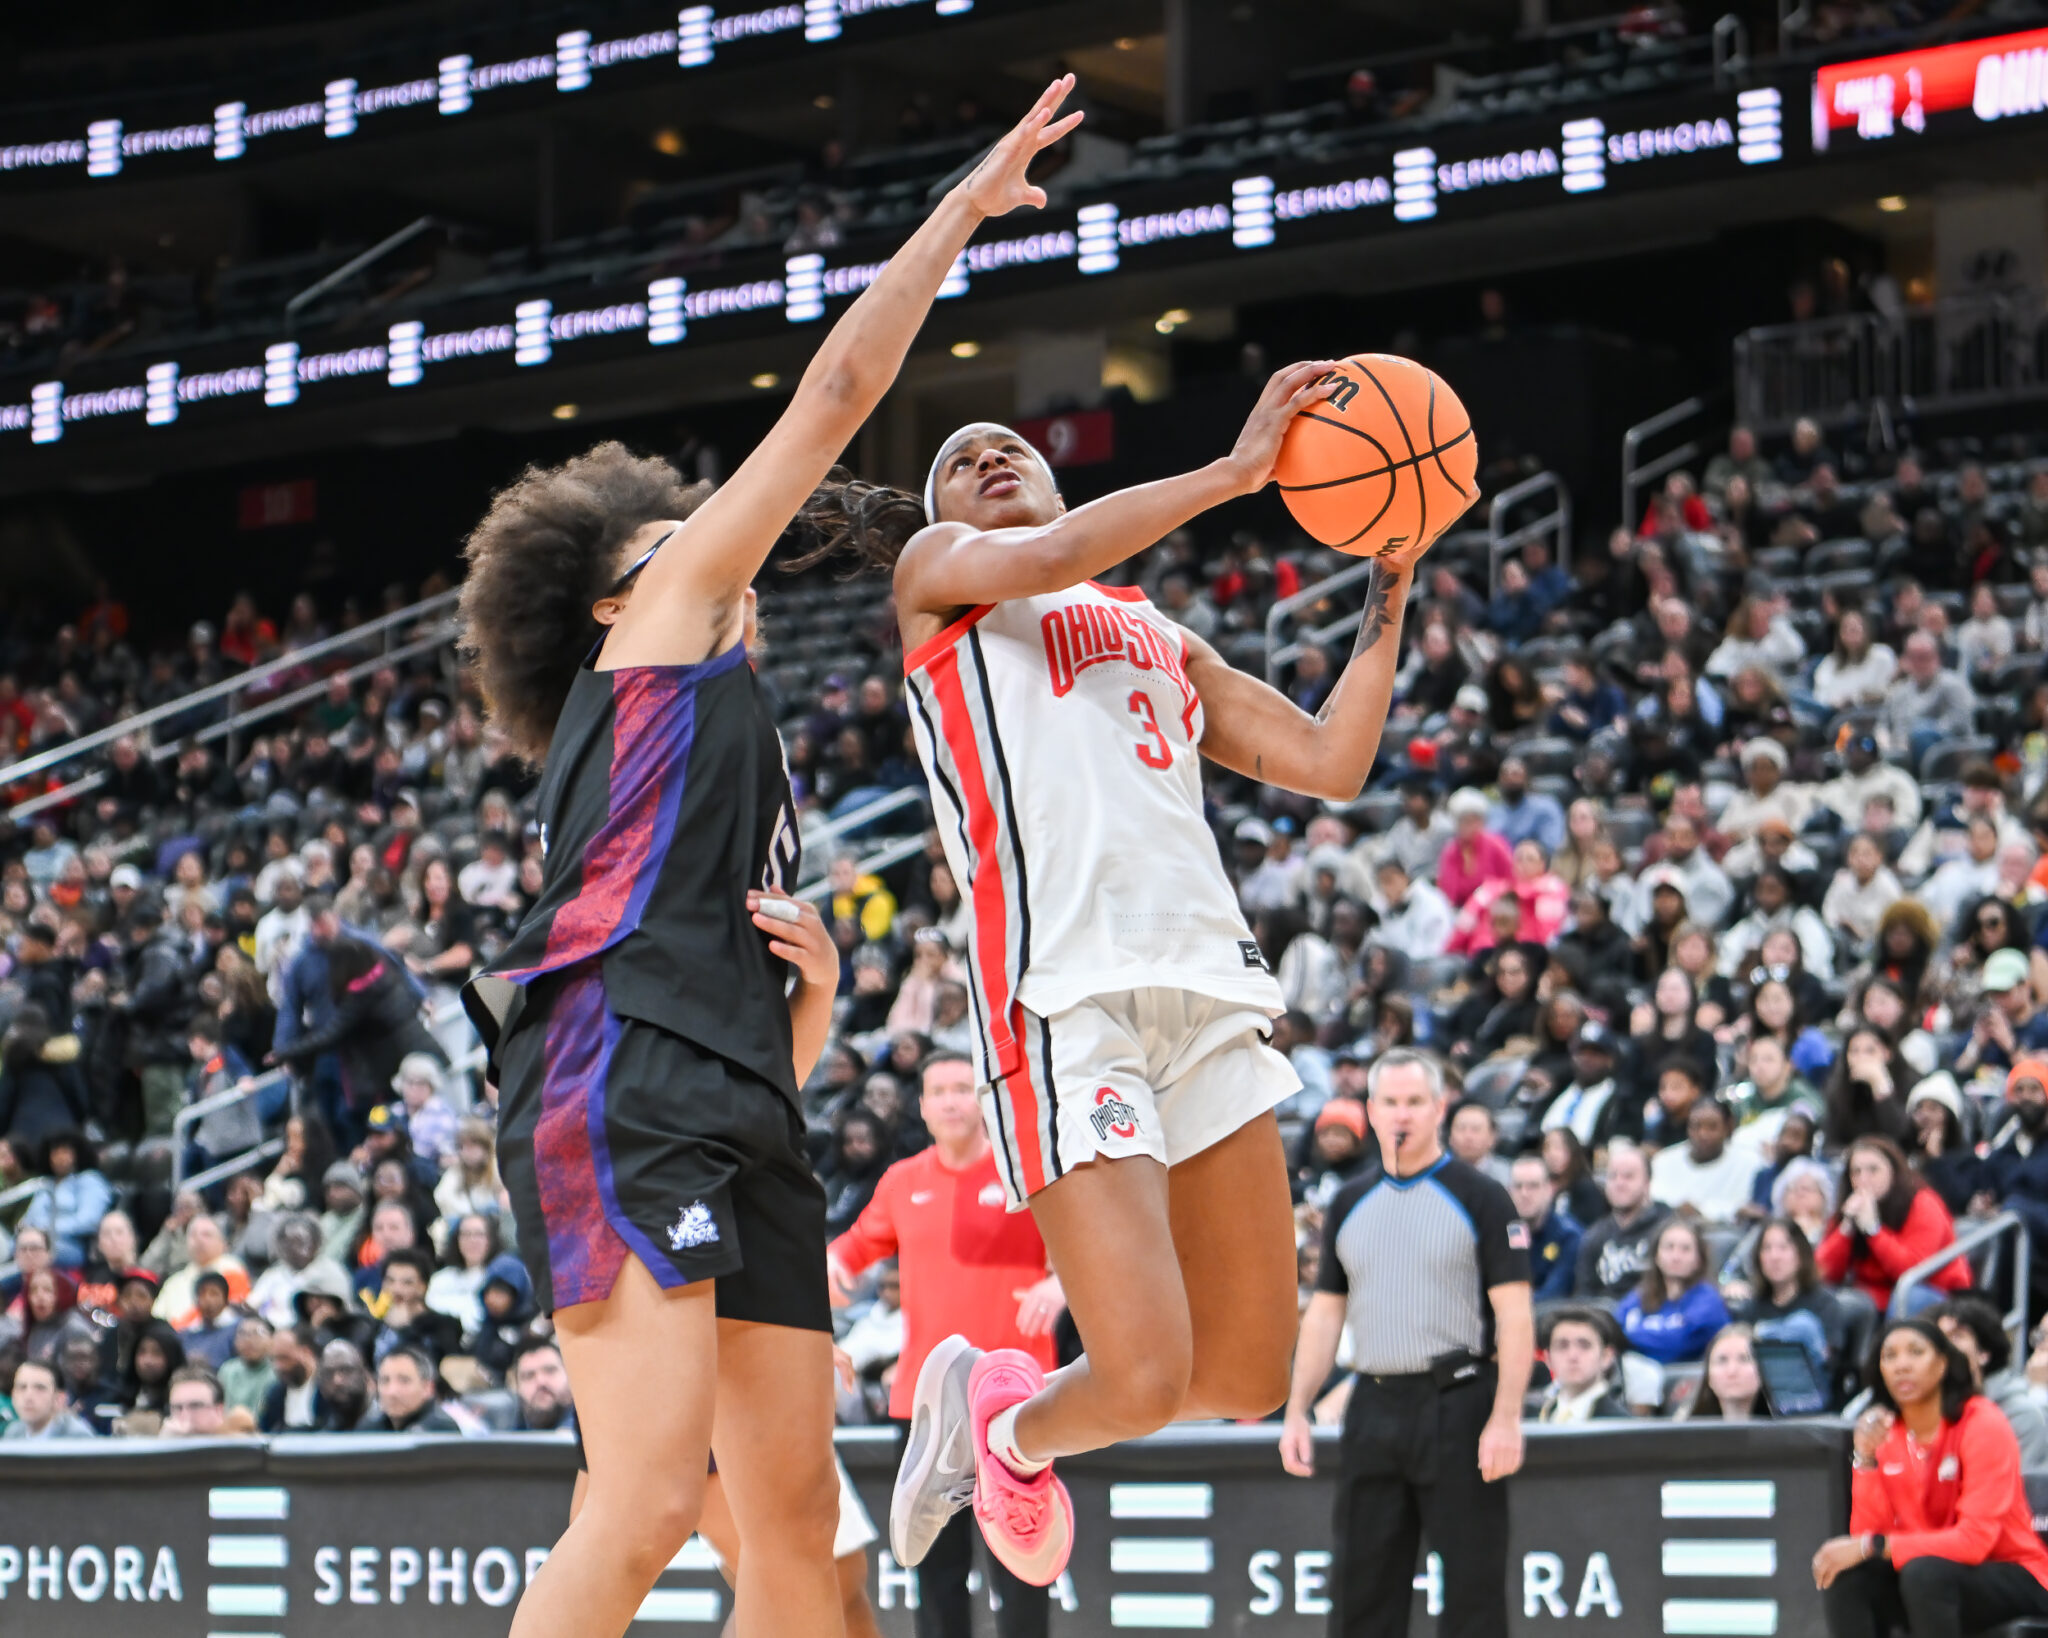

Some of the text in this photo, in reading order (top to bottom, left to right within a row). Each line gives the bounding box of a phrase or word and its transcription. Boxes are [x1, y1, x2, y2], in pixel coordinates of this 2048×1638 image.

[122, 123, 214, 156] SEPHORA
[244, 101, 324, 138] SEPHORA
[355, 78, 438, 115] SEPHORA
[469, 54, 556, 91] SEPHORA
[588, 29, 678, 68] SEPHORA
[711, 4, 803, 43] SEPHORA
[62, 386, 146, 421] SEPHORA
[177, 366, 264, 402] SEPHORA
[298, 345, 388, 383] SEPHORA
[421, 323, 516, 363] SEPHORA
[550, 302, 649, 341] SEPHORA
[684, 279, 785, 320] SEPHORA
[967, 230, 1077, 273] SEPHORA
[1118, 203, 1232, 246] SEPHORA
[1274, 176, 1393, 221] SEPHORA
[1437, 147, 1560, 193] SEPHORA
[1607, 117, 1734, 164] SEPHORA
[1040, 603, 1126, 698] OHIO
[1127, 689, 1173, 770] 3
[314, 1546, 551, 1607] SEPHO
